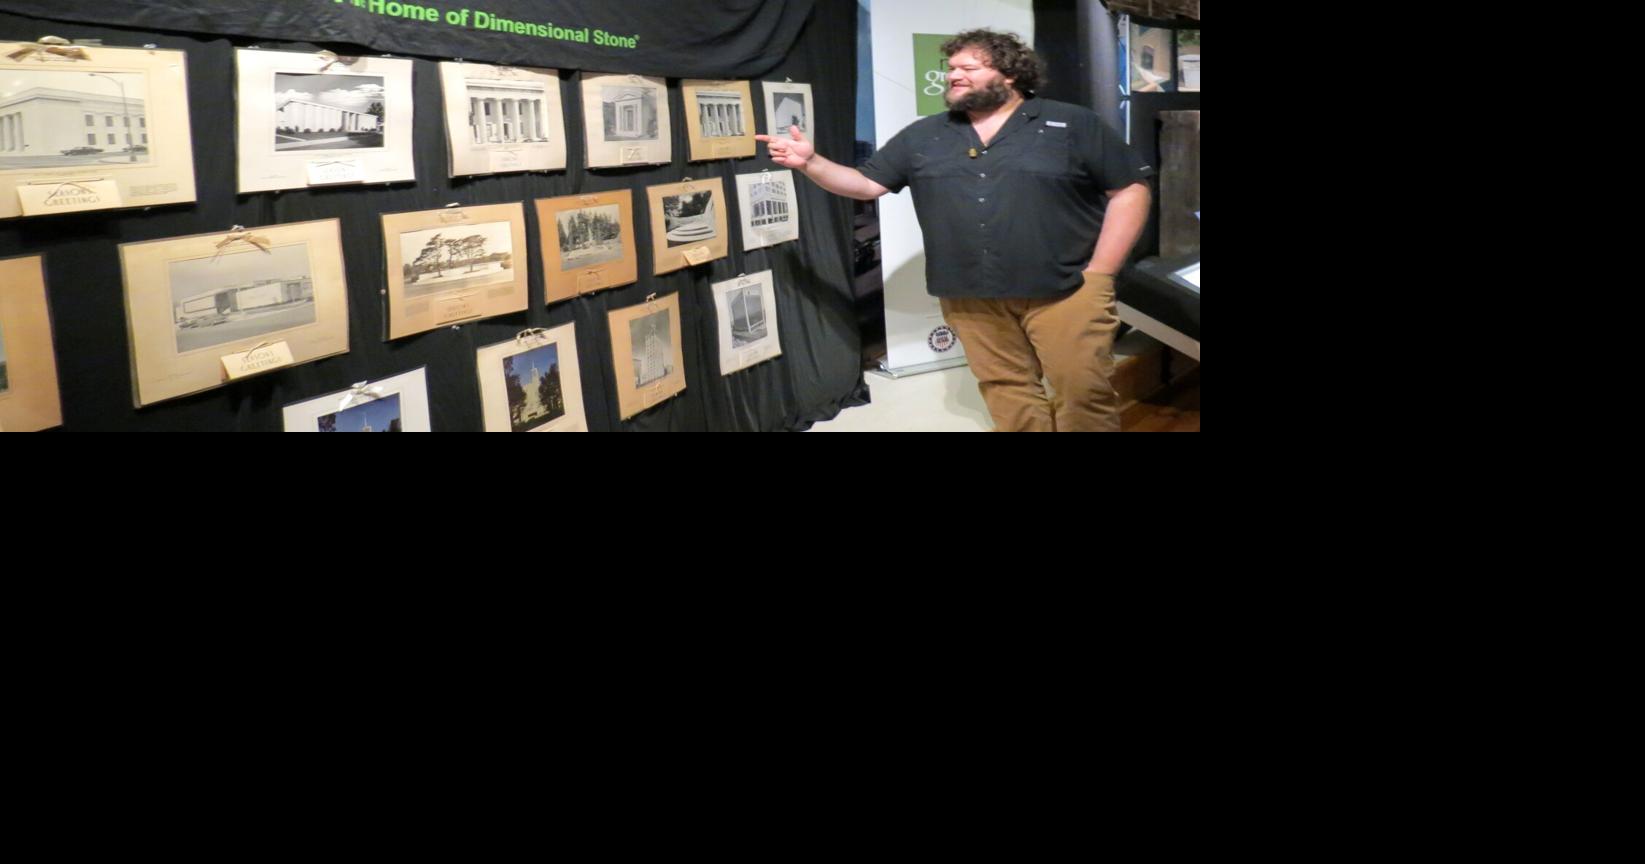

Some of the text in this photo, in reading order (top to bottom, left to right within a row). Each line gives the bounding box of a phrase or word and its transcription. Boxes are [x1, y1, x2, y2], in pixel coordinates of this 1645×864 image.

[368, 0, 439, 22] Home
[446, 9, 468, 27] of
[474, 11, 589, 43] Dimensional
